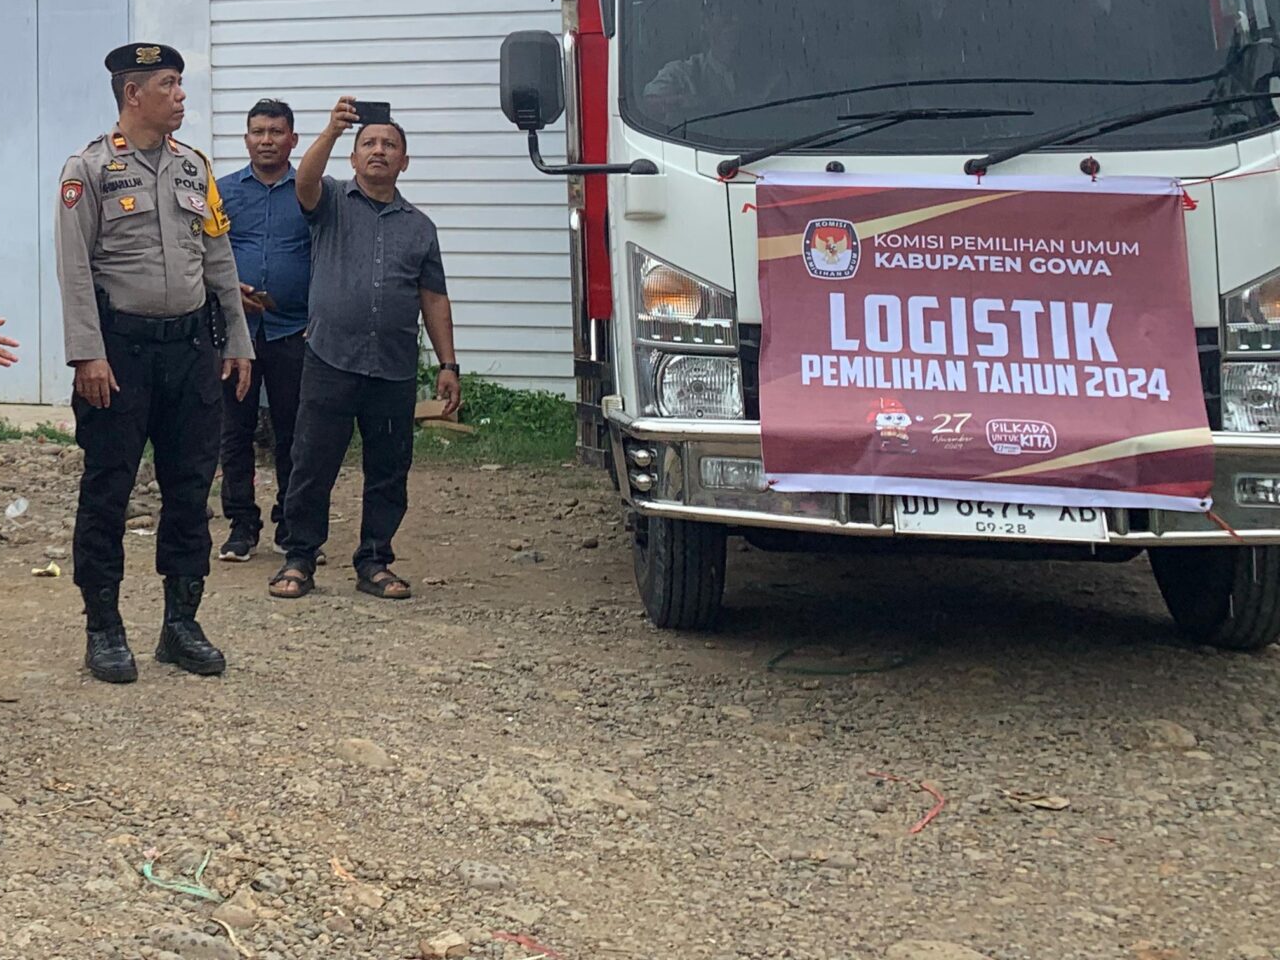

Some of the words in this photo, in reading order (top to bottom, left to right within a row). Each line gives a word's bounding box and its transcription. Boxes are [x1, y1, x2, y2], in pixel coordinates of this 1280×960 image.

[814, 220, 848, 230] KOMISI
[873, 233, 945, 250] KOMISI
[950, 235, 1065, 254] PEMILIHAN
[1071, 239, 1140, 257] UMUM
[873, 252, 1023, 273] KABUPATEN
[1028, 256, 1113, 277] GOWA
[828, 291, 1119, 363] LOGISTIK
[800, 353, 968, 392] PEMILIHAN
[972, 361, 1079, 398] TAHUN
[1083, 365, 1171, 403] 2024
[931, 412, 973, 434] 27
[991, 421, 1050, 434] PILKADA
[991, 433, 1020, 443] UNTUK
[1020, 433, 1053, 449] KITA
